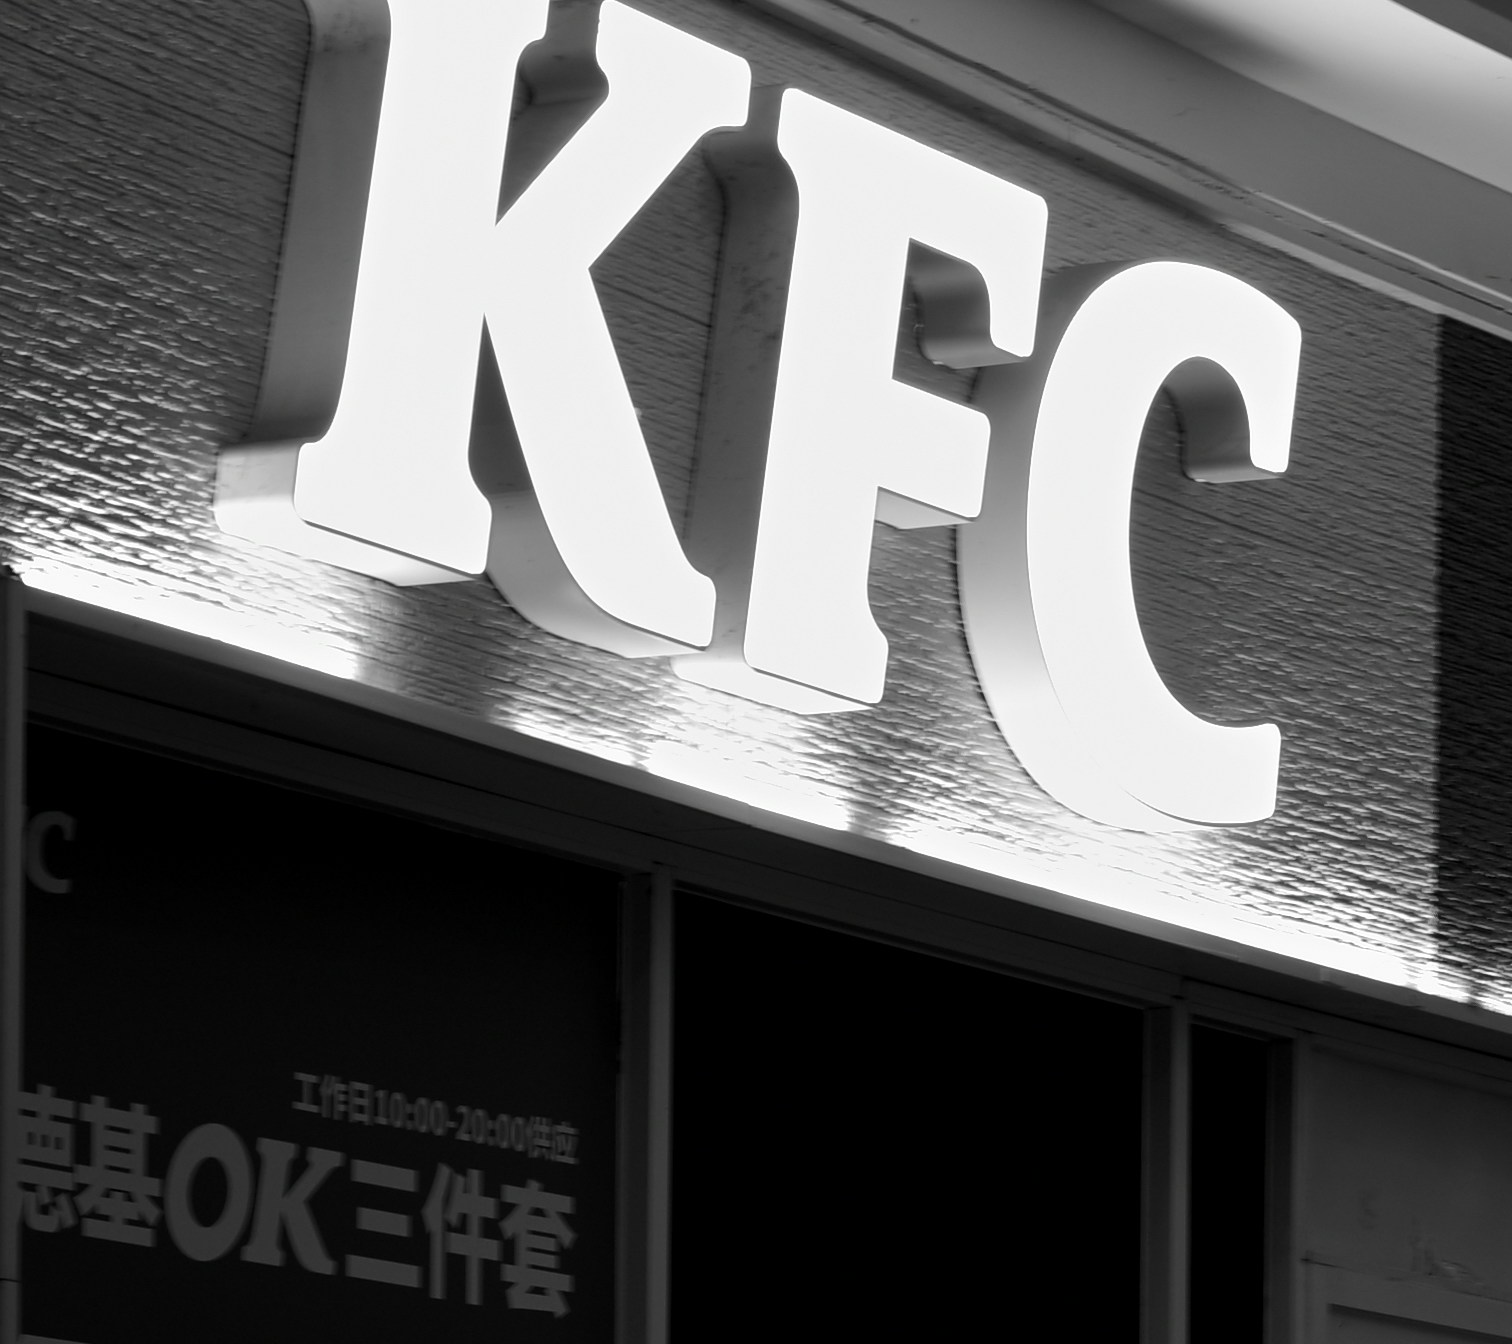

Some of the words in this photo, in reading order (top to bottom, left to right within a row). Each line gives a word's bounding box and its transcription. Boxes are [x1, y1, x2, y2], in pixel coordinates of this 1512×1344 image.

[288, 0, 1303, 830] KFC
[292, 1071, 581, 1165] 工作日10:00-20:00供应
